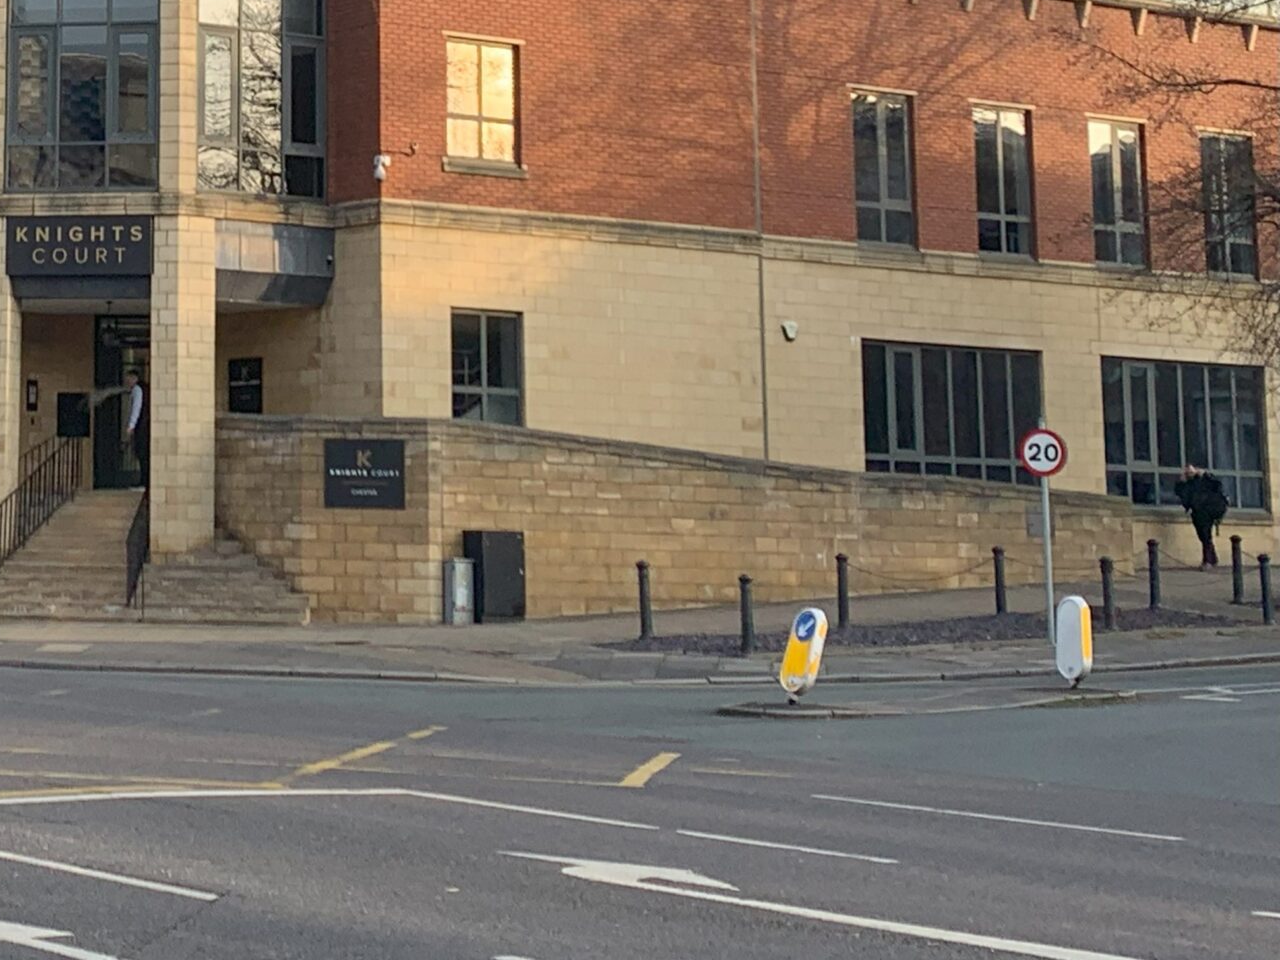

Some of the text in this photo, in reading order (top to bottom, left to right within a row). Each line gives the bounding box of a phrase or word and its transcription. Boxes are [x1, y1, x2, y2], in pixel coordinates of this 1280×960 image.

[15, 225, 144, 243] KNIGHTS
[32, 247, 127, 264] COURT
[1028, 443, 1058, 462] 20
